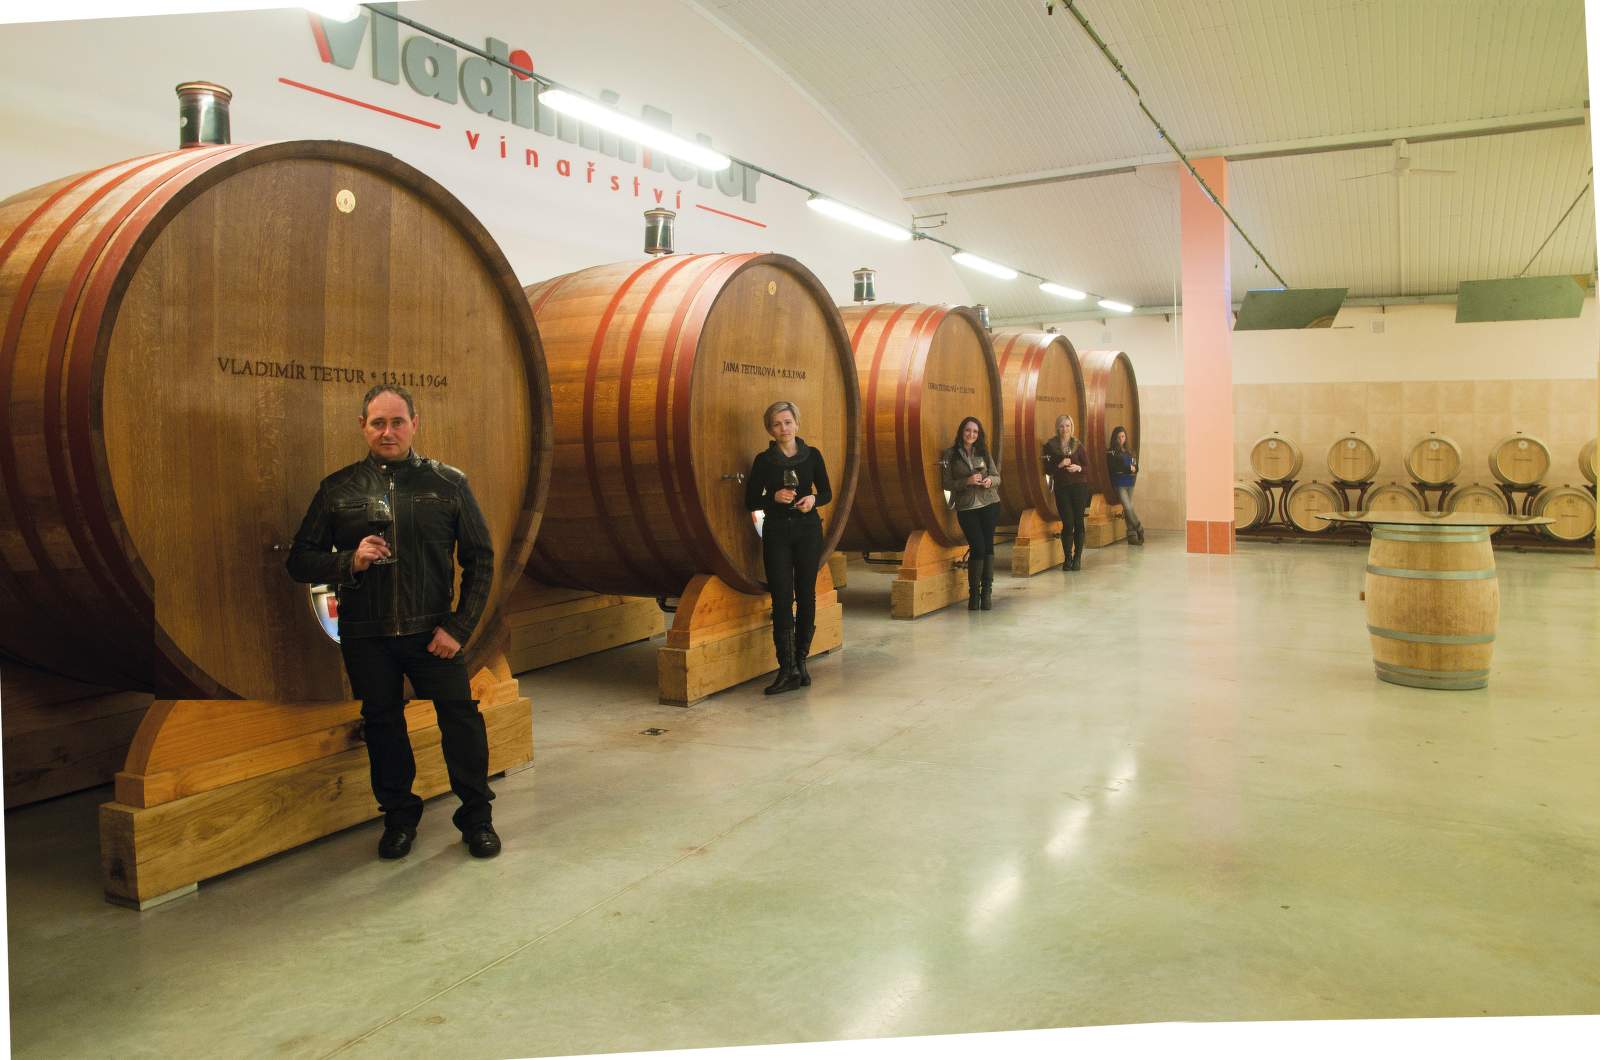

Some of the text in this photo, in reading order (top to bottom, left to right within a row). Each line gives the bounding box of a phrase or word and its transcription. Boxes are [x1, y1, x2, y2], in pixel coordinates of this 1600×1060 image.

[465, 129, 683, 210] vinařství
[217, 357, 448, 388] VLADIMÍR TETUR 13.11.1964
